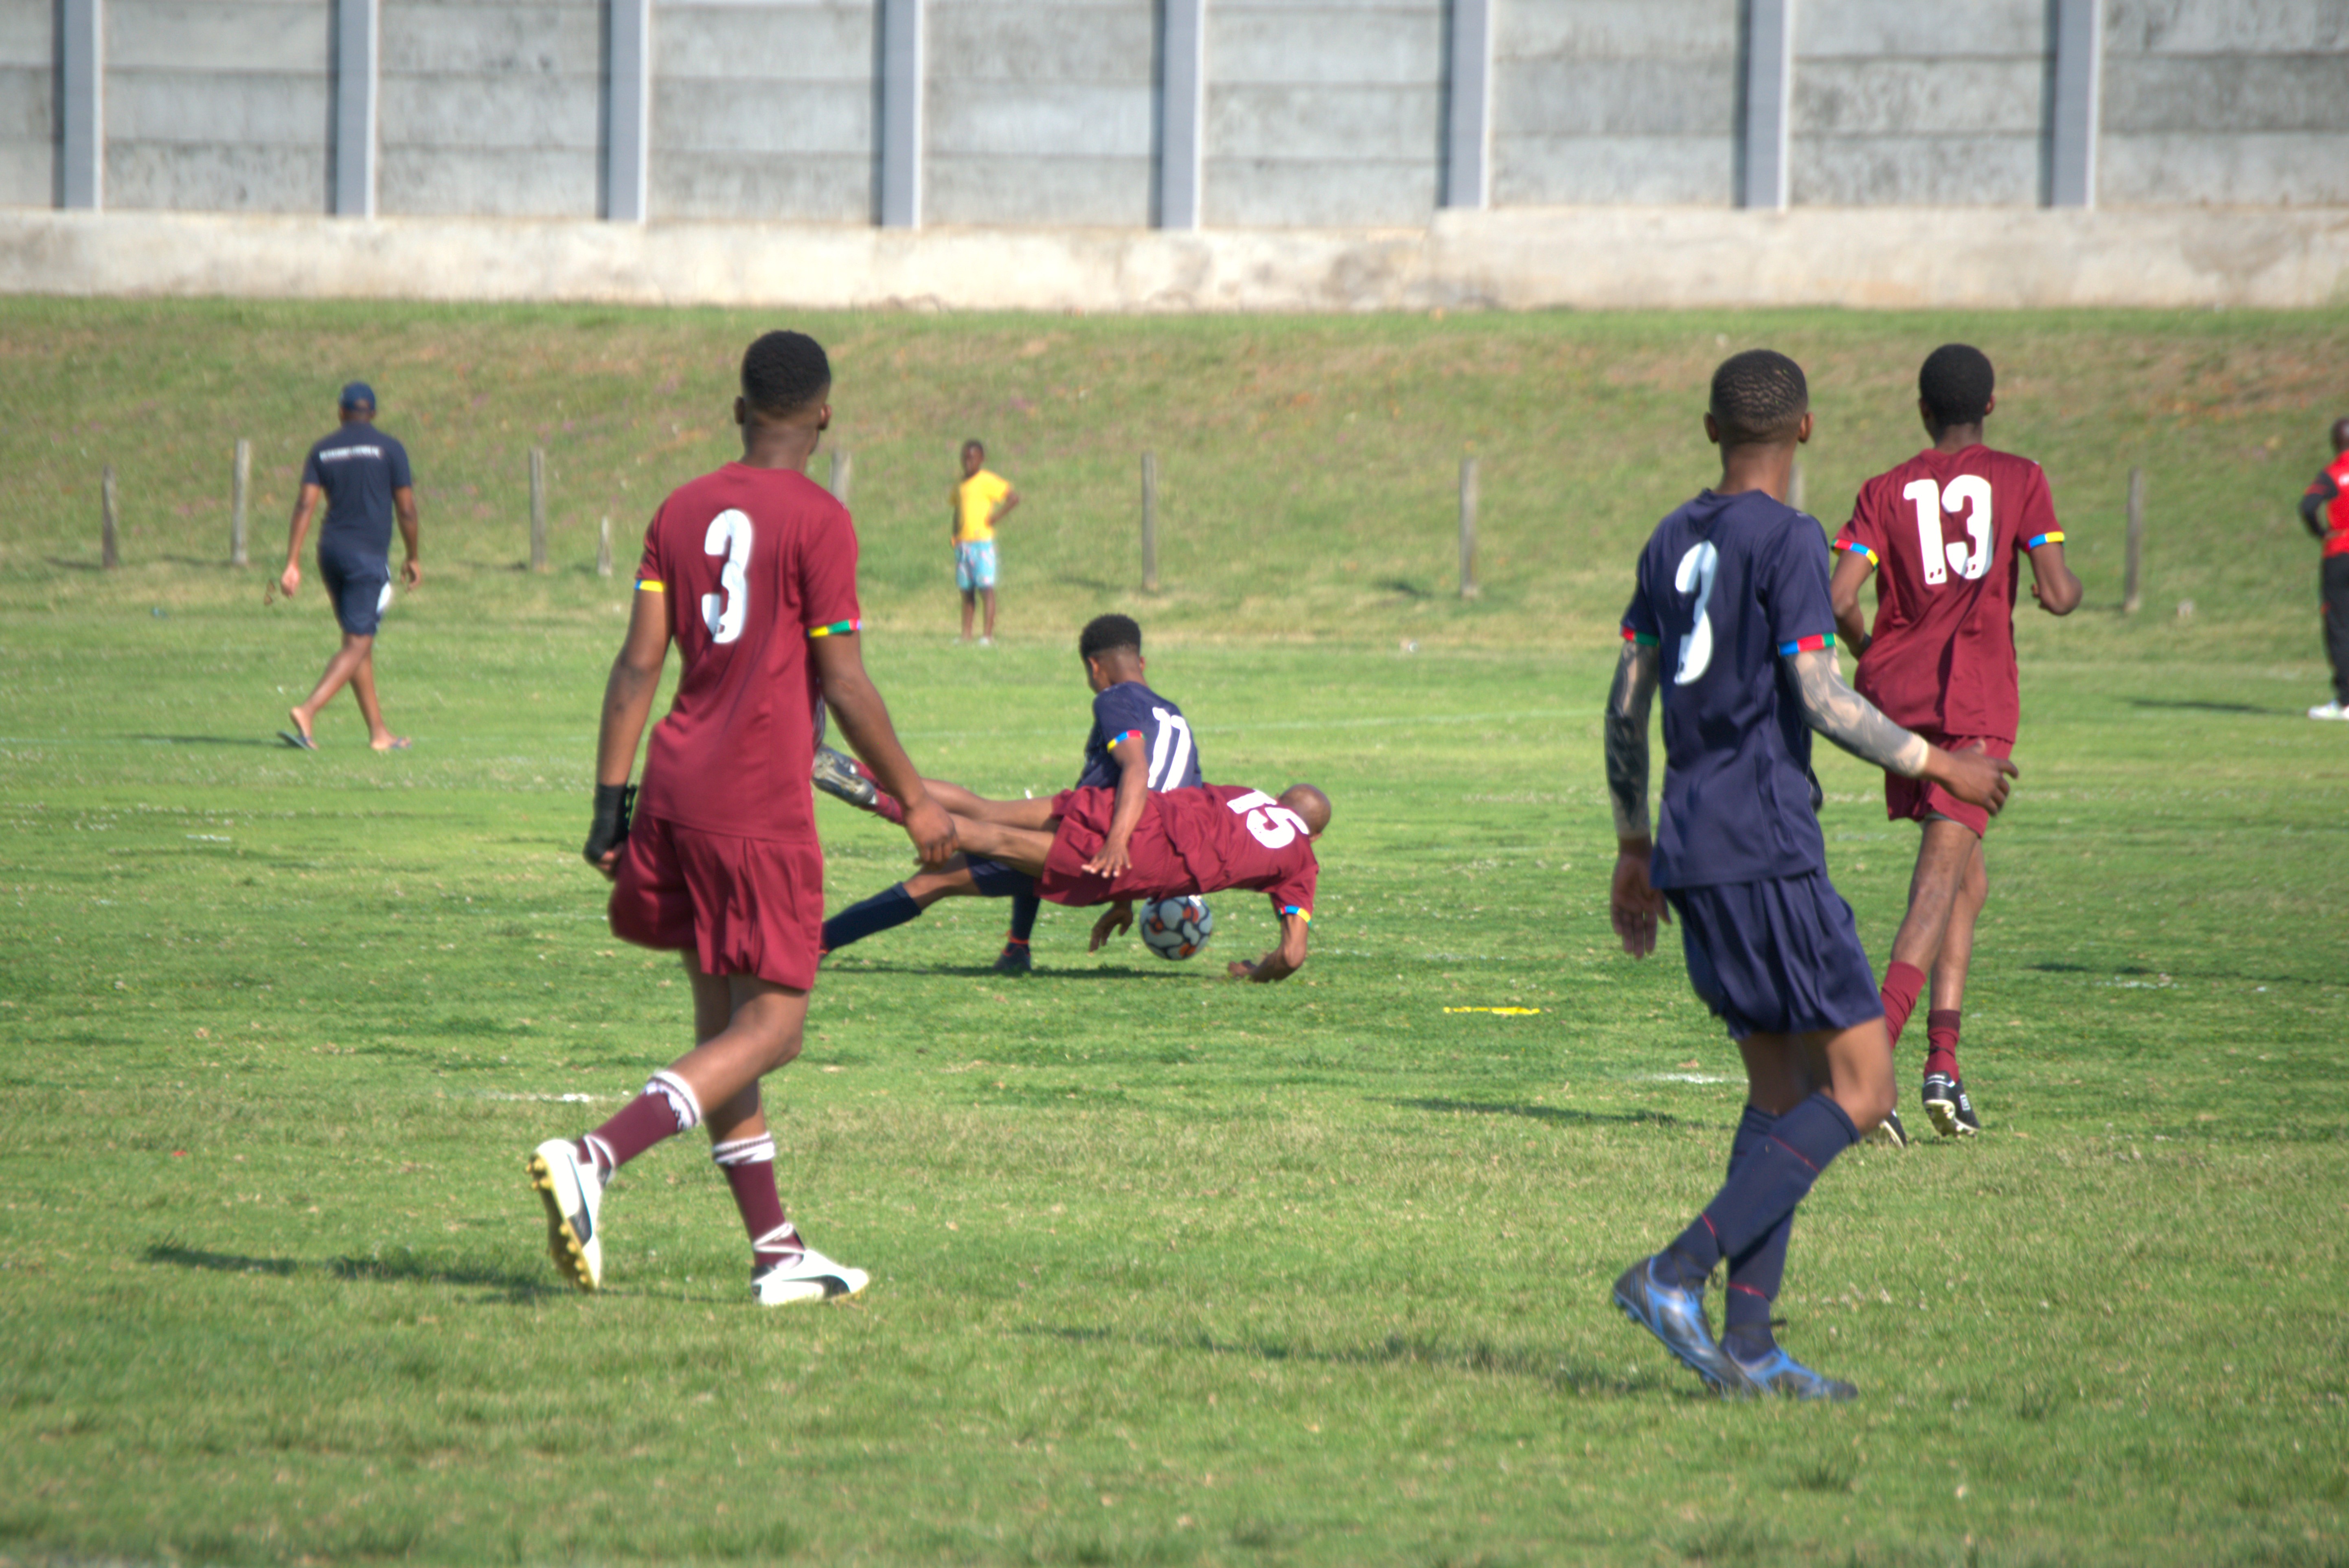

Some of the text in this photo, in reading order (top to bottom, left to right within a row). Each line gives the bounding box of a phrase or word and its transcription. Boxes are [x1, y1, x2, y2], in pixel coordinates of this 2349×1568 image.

[701, 508, 752, 644] 3
[1903, 474, 1993, 585] 13
[1673, 540, 1718, 685] 3
[1226, 788, 1310, 849] 15
